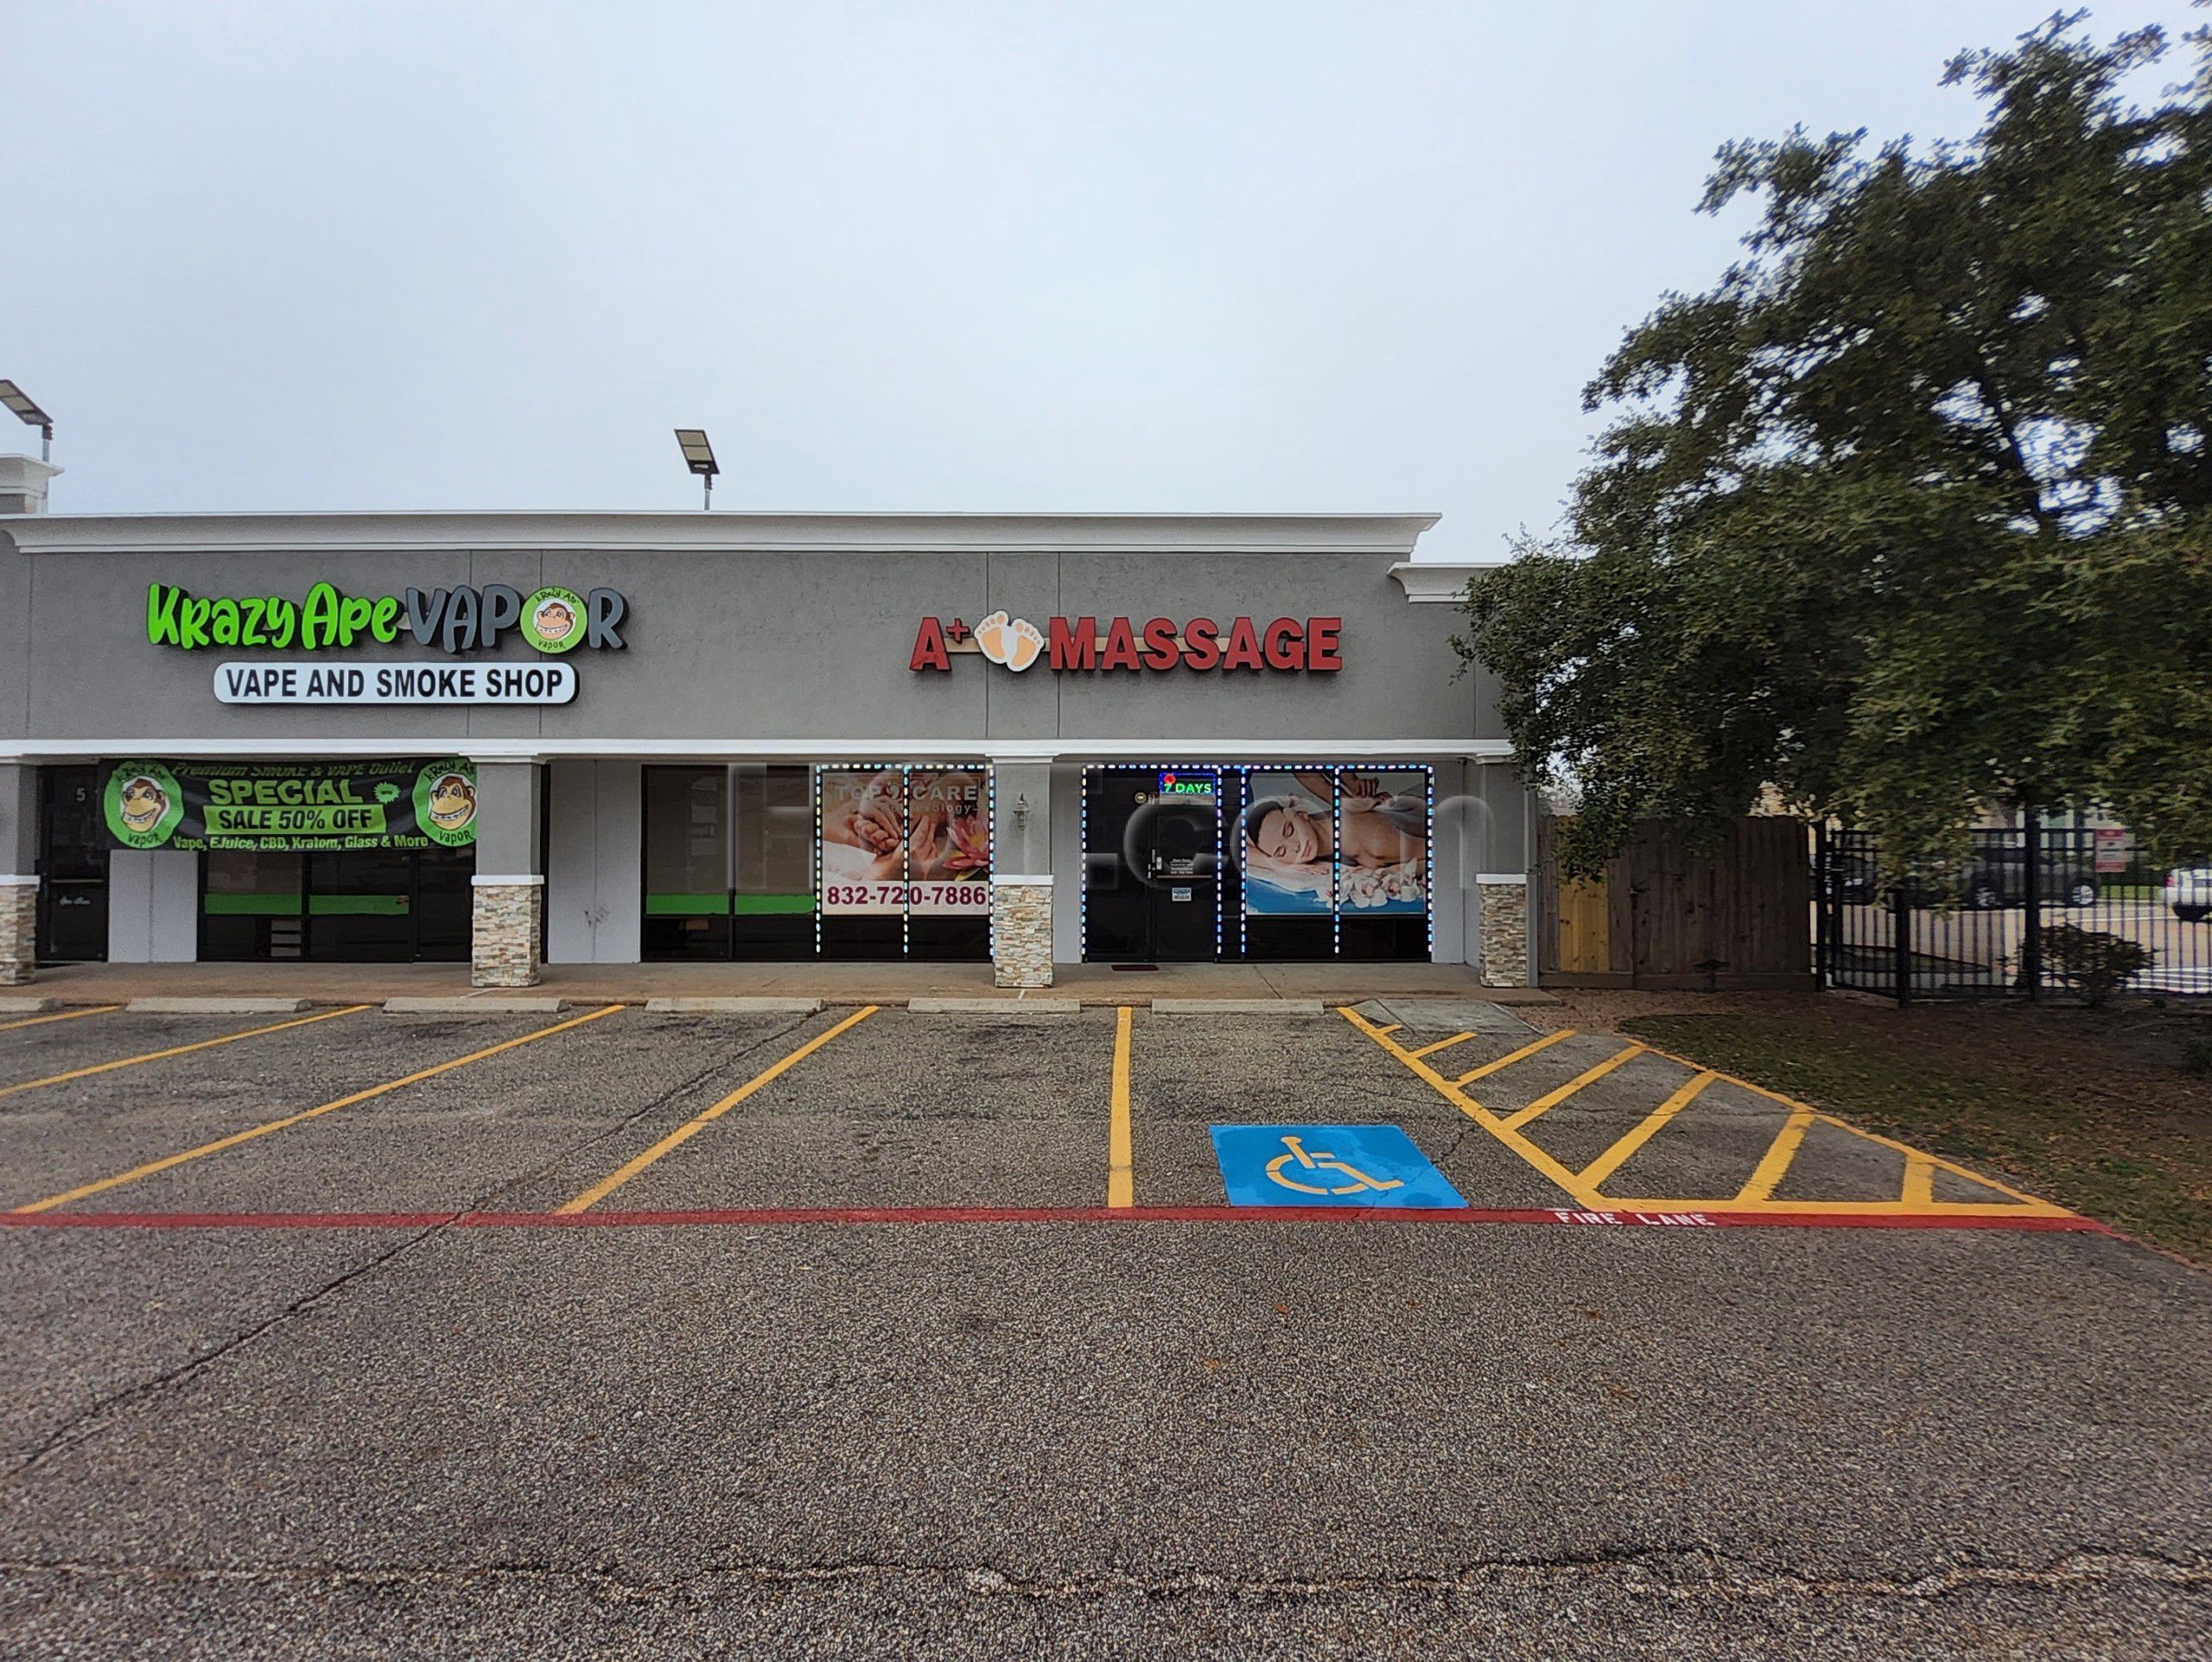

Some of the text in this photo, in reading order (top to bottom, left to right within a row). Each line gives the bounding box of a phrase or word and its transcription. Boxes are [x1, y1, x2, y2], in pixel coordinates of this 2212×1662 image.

[302, 581, 398, 649] Ape
[909, 616, 1343, 672] A+ MASSAGE
[226, 668, 563, 697] VAPE AND SMOKE SHOP
[327, 763, 368, 776] VAPE
[76, 787, 86, 802] 5
[208, 779, 364, 805] SPECIAL
[912, 785, 978, 801] CARE
[1164, 782, 1212, 794] 7 DAYS
[219, 809, 372, 831] SALE 50% OFF
[174, 836, 207, 851] Vape,
[259, 837, 289, 851] CBD,
[292, 836, 341, 851] Kratom,
[346, 836, 378, 849] Glass
[381, 836, 391, 848] &
[394, 834, 429, 848] More
[827, 886, 987, 906] 832-720-7886
[1555, 1212, 1717, 1226] FIRE LANE
